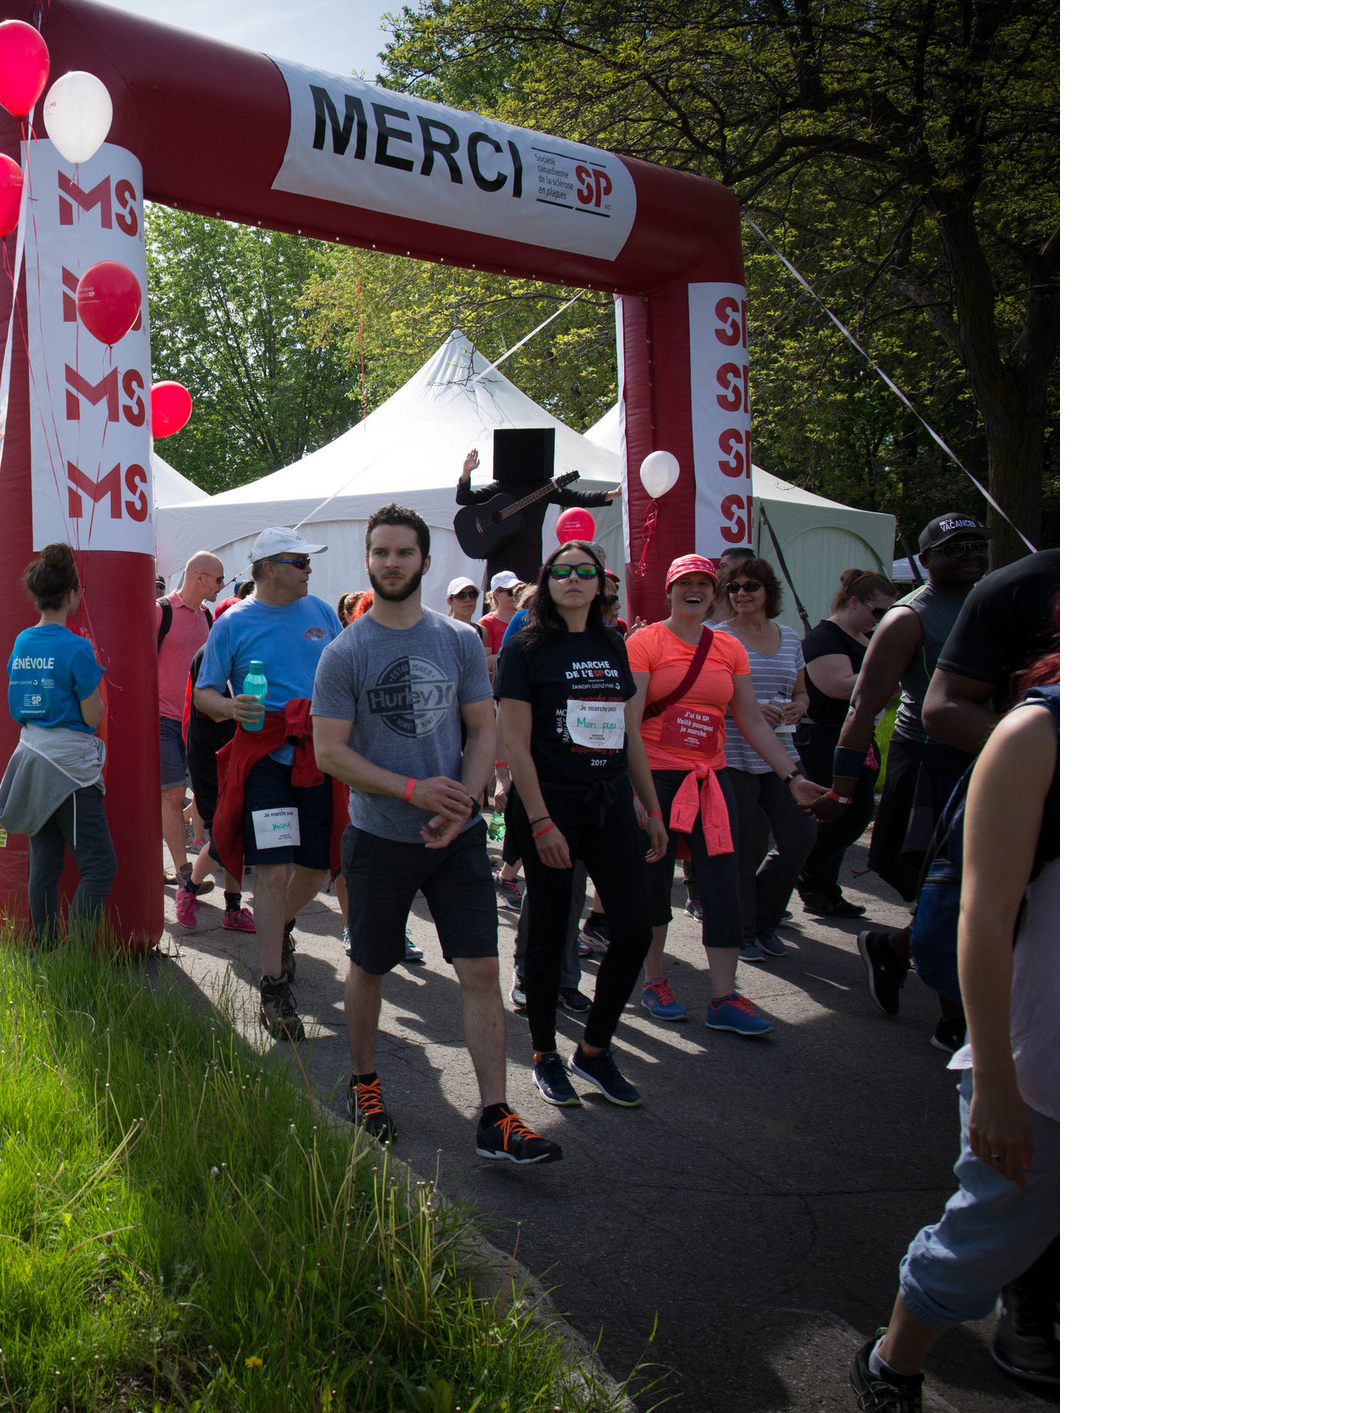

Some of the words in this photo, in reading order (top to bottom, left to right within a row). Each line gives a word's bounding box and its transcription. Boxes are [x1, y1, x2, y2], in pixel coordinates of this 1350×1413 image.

[309, 85, 523, 198] MERCI
[575, 165, 612, 208] SP
[58, 169, 139, 237] MS
[64, 362, 146, 427] MS
[67, 459, 148, 522] MS
[565, 670, 580, 679] DE
[581, 669, 619, 678] L'ESPOIR
[572, 660, 611, 670] MARCHE
[31, 695, 42, 705] SP
[369, 687, 433, 709] Hurley
[684, 711, 695, 719] J'ai
